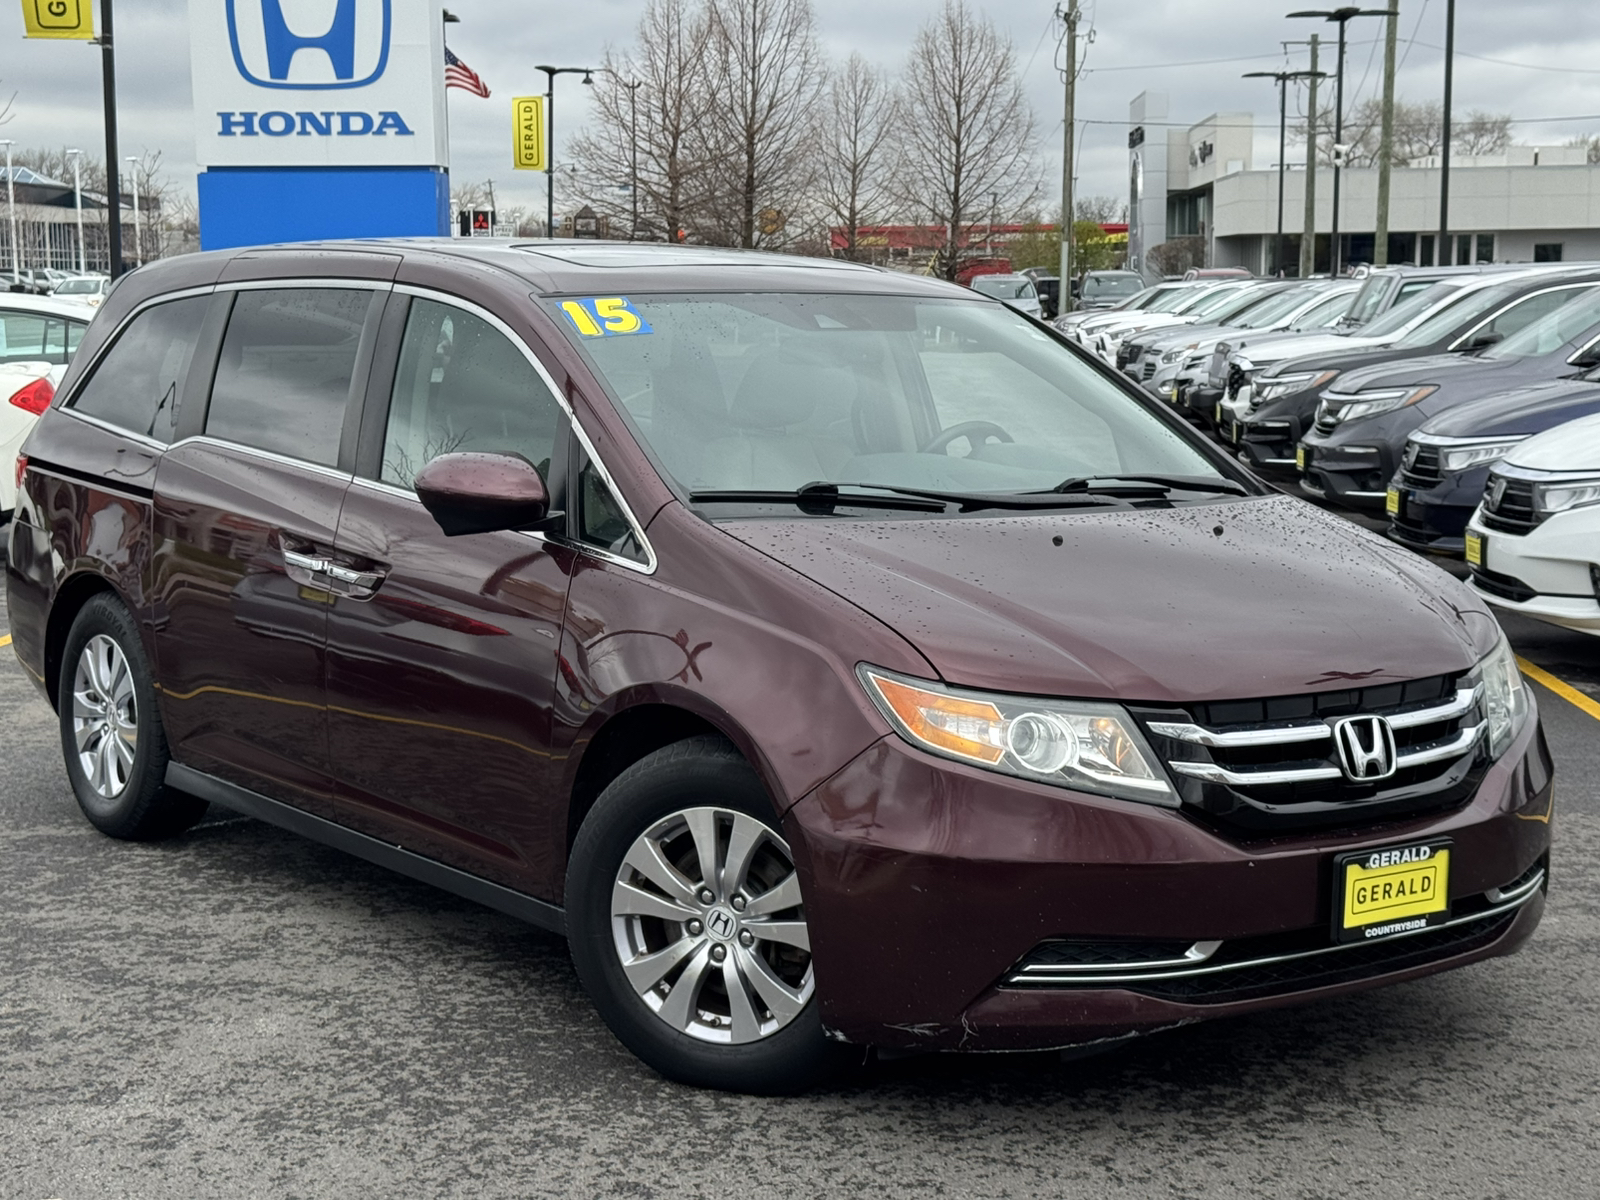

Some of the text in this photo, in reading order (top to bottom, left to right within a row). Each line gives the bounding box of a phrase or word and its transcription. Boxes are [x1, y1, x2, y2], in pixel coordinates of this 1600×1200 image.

[216, 111, 415, 136] HONDA
[523, 105, 534, 161] GERALD
[562, 298, 642, 336] 15
[1369, 846, 1431, 869] GERALD
[1356, 875, 1431, 905] GERALD
[1365, 918, 1427, 938] COUNTRYSIDE
